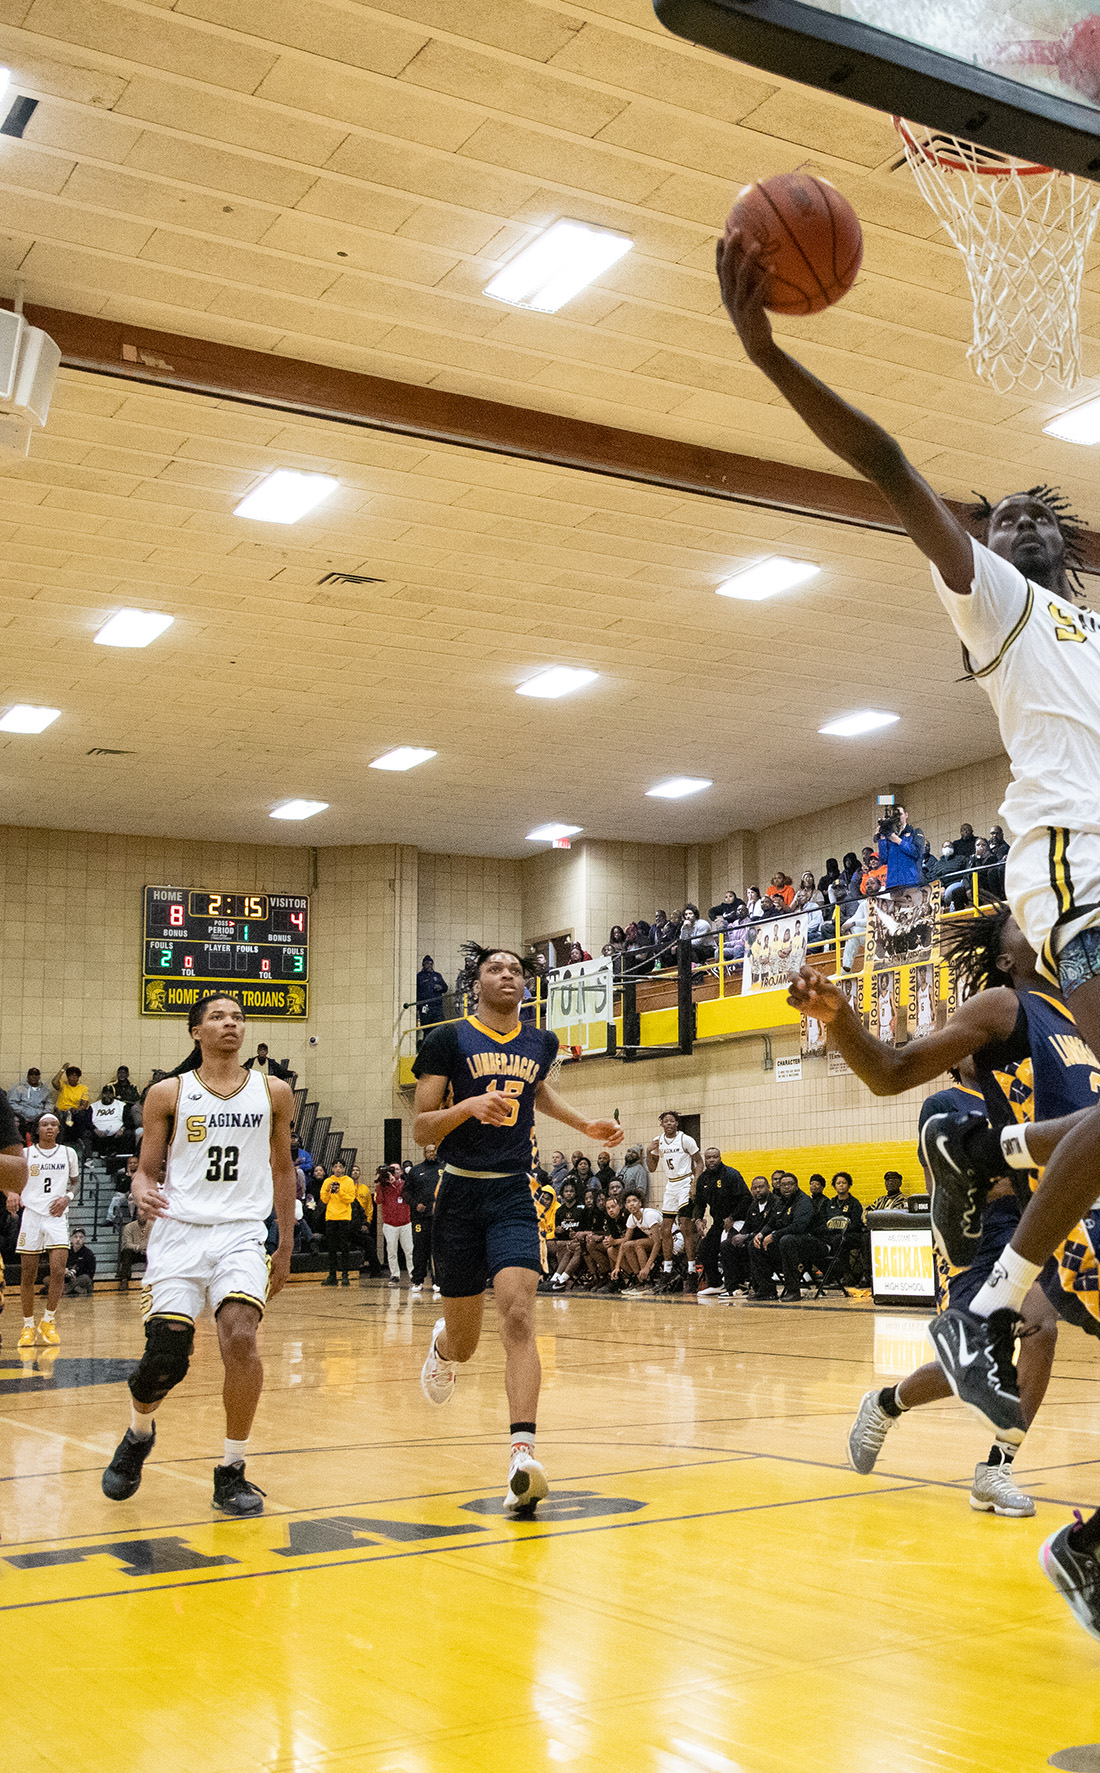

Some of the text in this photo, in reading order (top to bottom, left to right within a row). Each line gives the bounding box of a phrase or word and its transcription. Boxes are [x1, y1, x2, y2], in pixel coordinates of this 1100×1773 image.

[153, 891, 183, 901] HOME
[208, 894, 262, 917] 2:15
[270, 897, 306, 909] VISITOR
[170, 904, 184, 926] 8
[290, 912, 304, 932] 4
[163, 929, 188, 937] BONUS
[208, 926, 235, 934] PERIOD
[243, 924, 249, 941] 1
[268, 934, 292, 942] BONUS
[150, 941, 173, 950] FOULS
[204, 943, 259, 953] PLAYER FOULS
[282, 947, 305, 955] FOULS
[161, 949, 173, 967] 2
[184, 955, 193, 968] 0
[293, 955, 304, 972] 3
[261, 959, 270, 971] 0
[259, 971, 272, 979] TOL
[168, 988, 199, 1004] HOME
[242, 991, 285, 1007] TROJANS
[466, 1052, 540, 1084] LUMBERJACKS
[777, 1058, 800, 1067] CHARACTER
[96, 1108, 116, 1117] 1906
[186, 1113, 264, 1143] SAGINAW
[206, 1145, 240, 1181] 32
[30, 1163, 66, 1177] SAGINAW
[44, 1177, 51, 1193] 2
[874, 1245, 933, 1279] SAGINAW
[884, 1282, 925, 1292] HIGH SCHOOL
